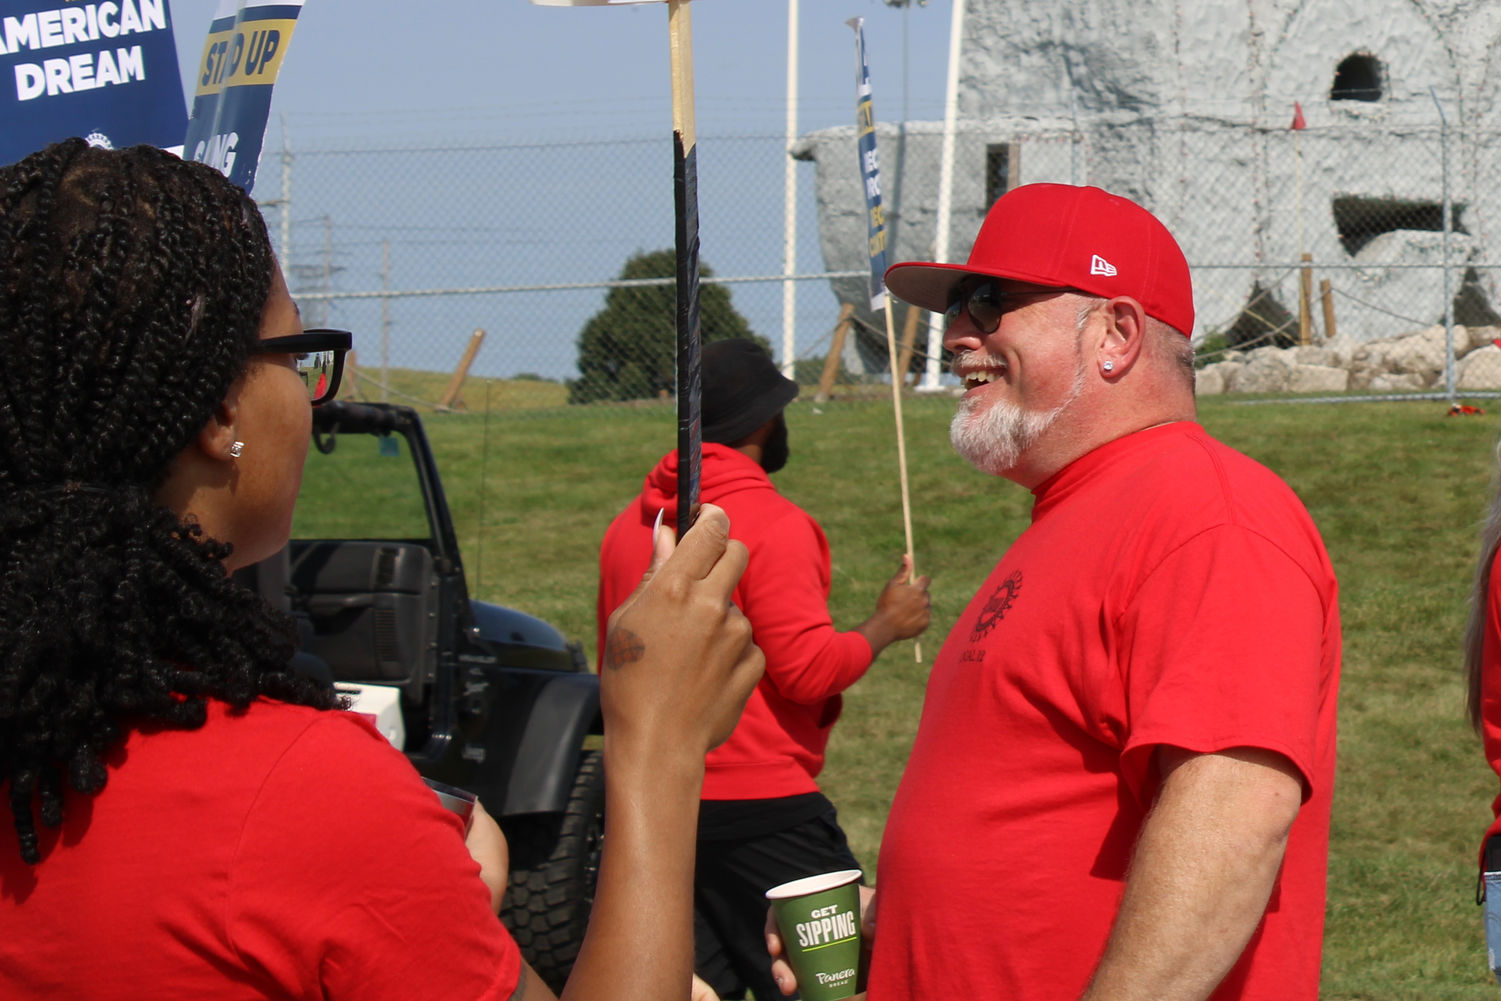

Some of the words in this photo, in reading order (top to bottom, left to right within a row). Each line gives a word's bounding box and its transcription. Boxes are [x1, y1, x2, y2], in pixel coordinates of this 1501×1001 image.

[245, 29, 280, 76] UP
[15, 45, 146, 101] DREAM
[796, 911, 856, 947] SIPPING
[811, 905, 838, 919] GET
[816, 968, 855, 985] Panera
